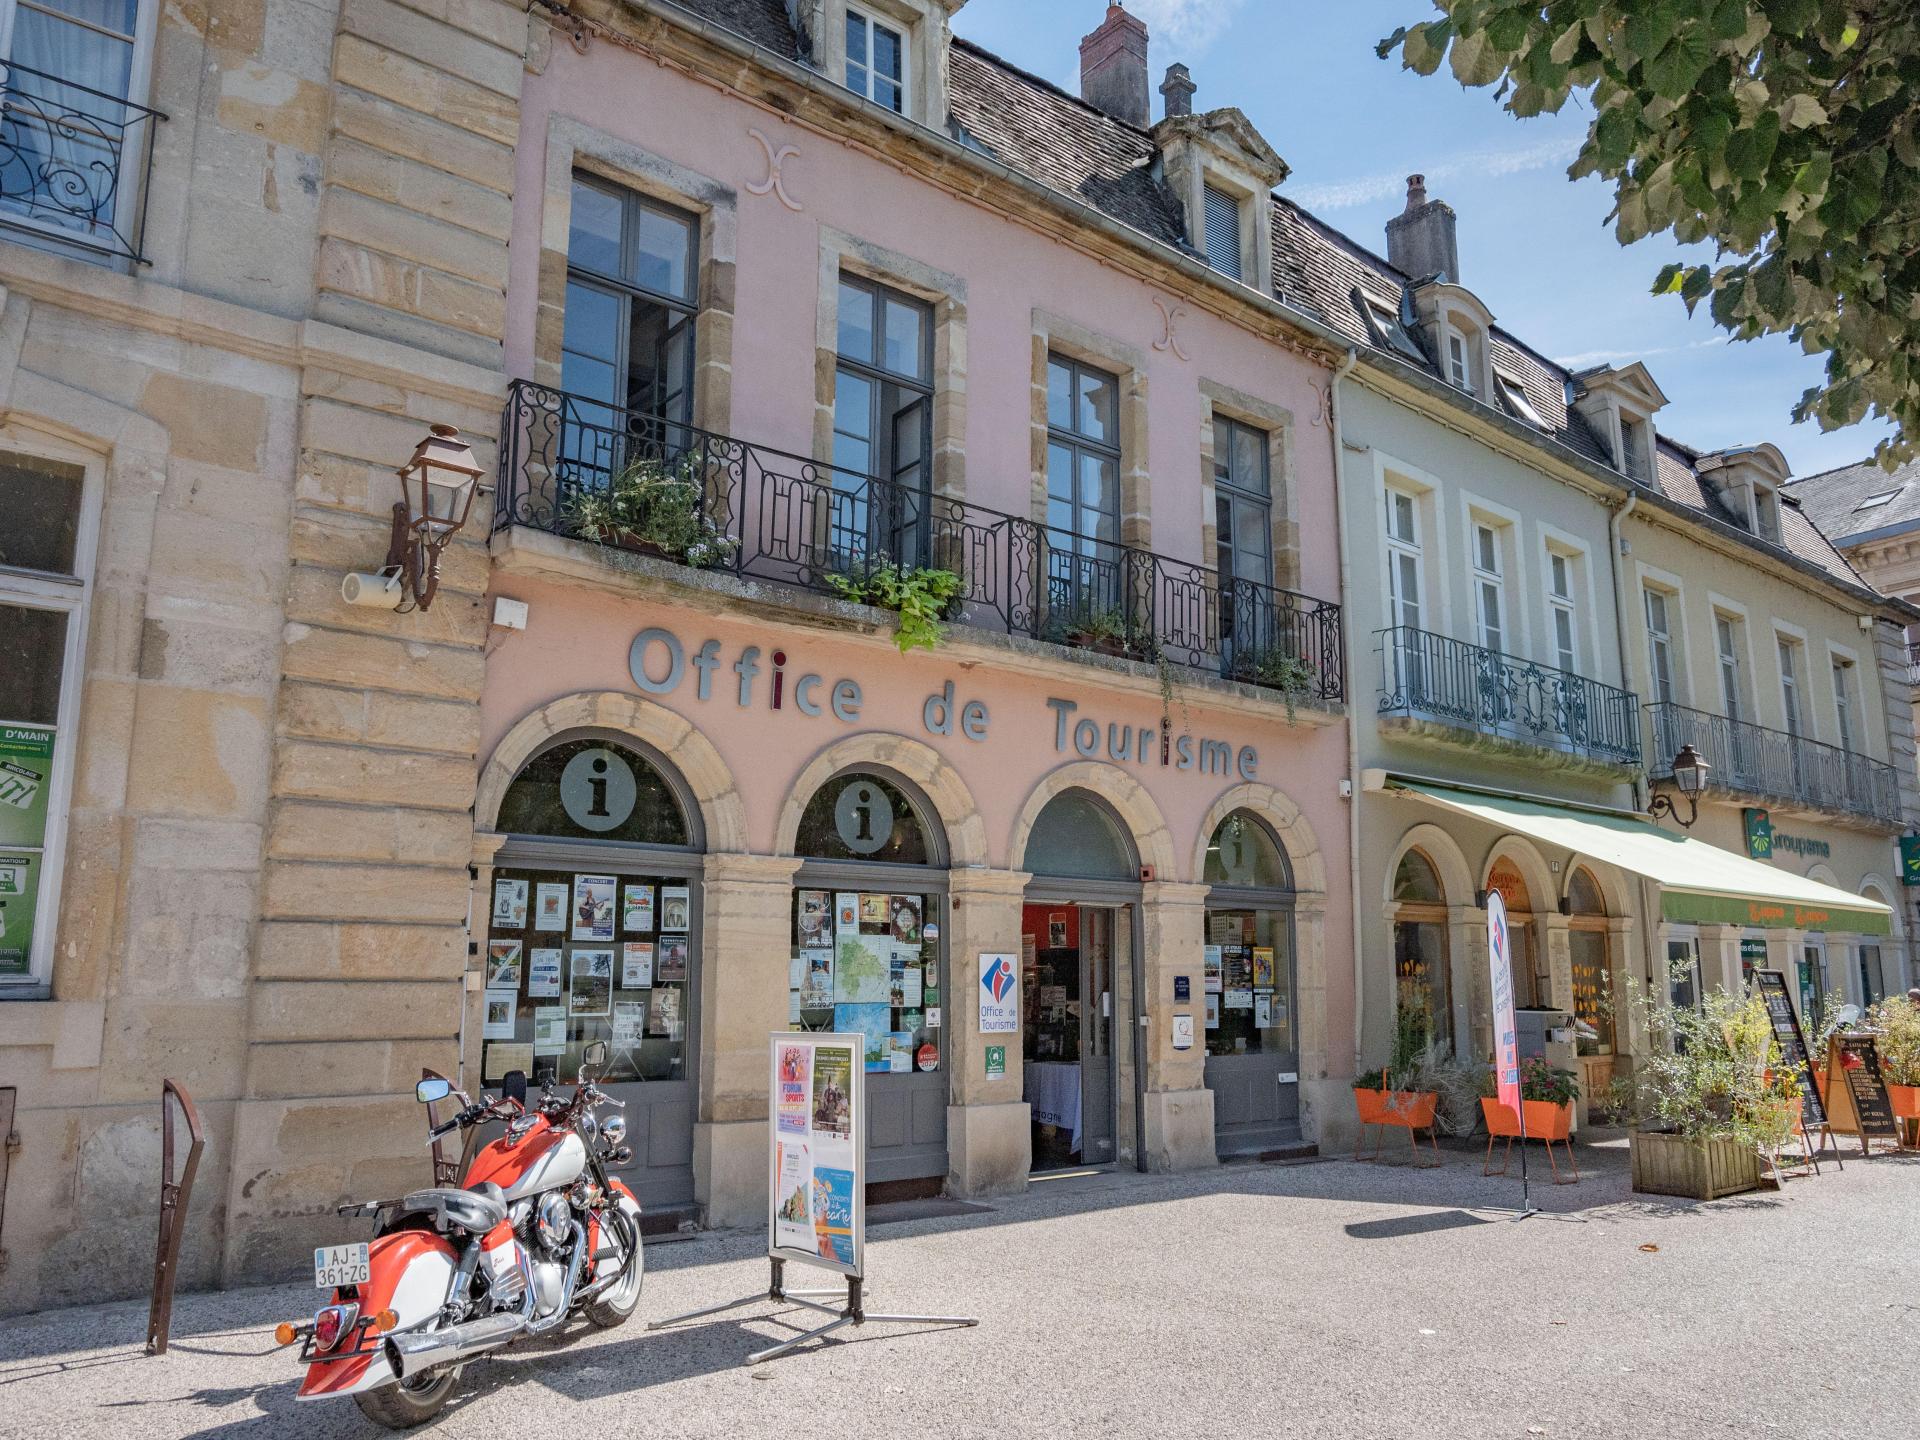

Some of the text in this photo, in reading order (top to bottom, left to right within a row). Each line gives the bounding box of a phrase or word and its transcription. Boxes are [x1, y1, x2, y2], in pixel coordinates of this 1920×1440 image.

[628, 627, 1258, 781] Office de Tourisme
[5, 730, 49, 741] D'MAIN
[5, 764, 37, 778] BRICOLAGE
[981, 1005, 1016, 1017] Office de
[982, 1018, 1016, 1030] Tourisme
[826, 1208, 851, 1226] carte
[318, 1265, 367, 1286] 361-ZG
